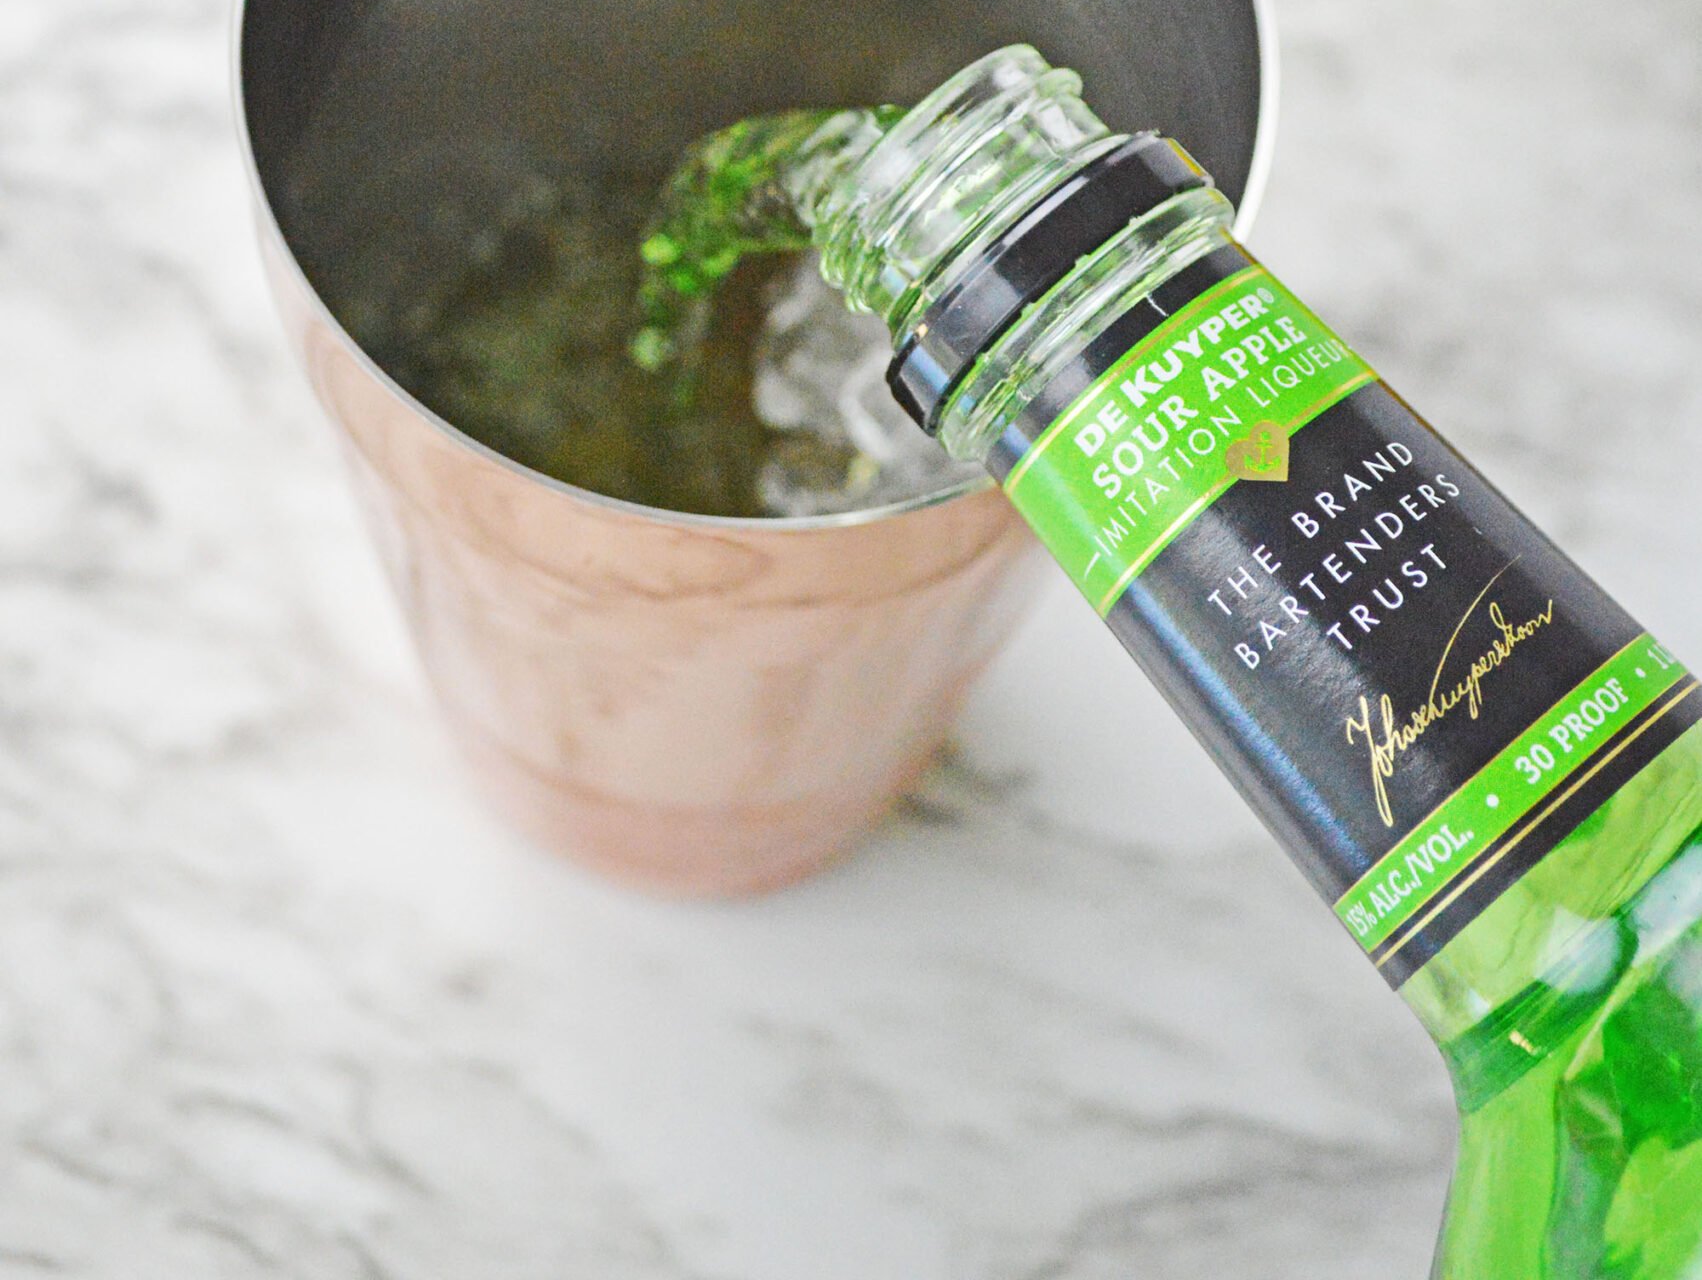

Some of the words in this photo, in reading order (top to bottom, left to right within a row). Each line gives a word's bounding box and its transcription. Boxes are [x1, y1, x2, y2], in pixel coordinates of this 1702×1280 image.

[1073, 399, 1129, 458] DE
[1091, 394, 1199, 500] SOUR
[1200, 315, 1307, 402] APPLE
[1093, 404, 1243, 558] IMITATION
[1207, 543, 1282, 616] THE
[1290, 441, 1413, 539] BRAND
[1233, 473, 1460, 670] BARTENDERS
[1325, 543, 1447, 650] TRUST
[1514, 743, 1555, 785] 30
[1548, 677, 1629, 754] PROOF
